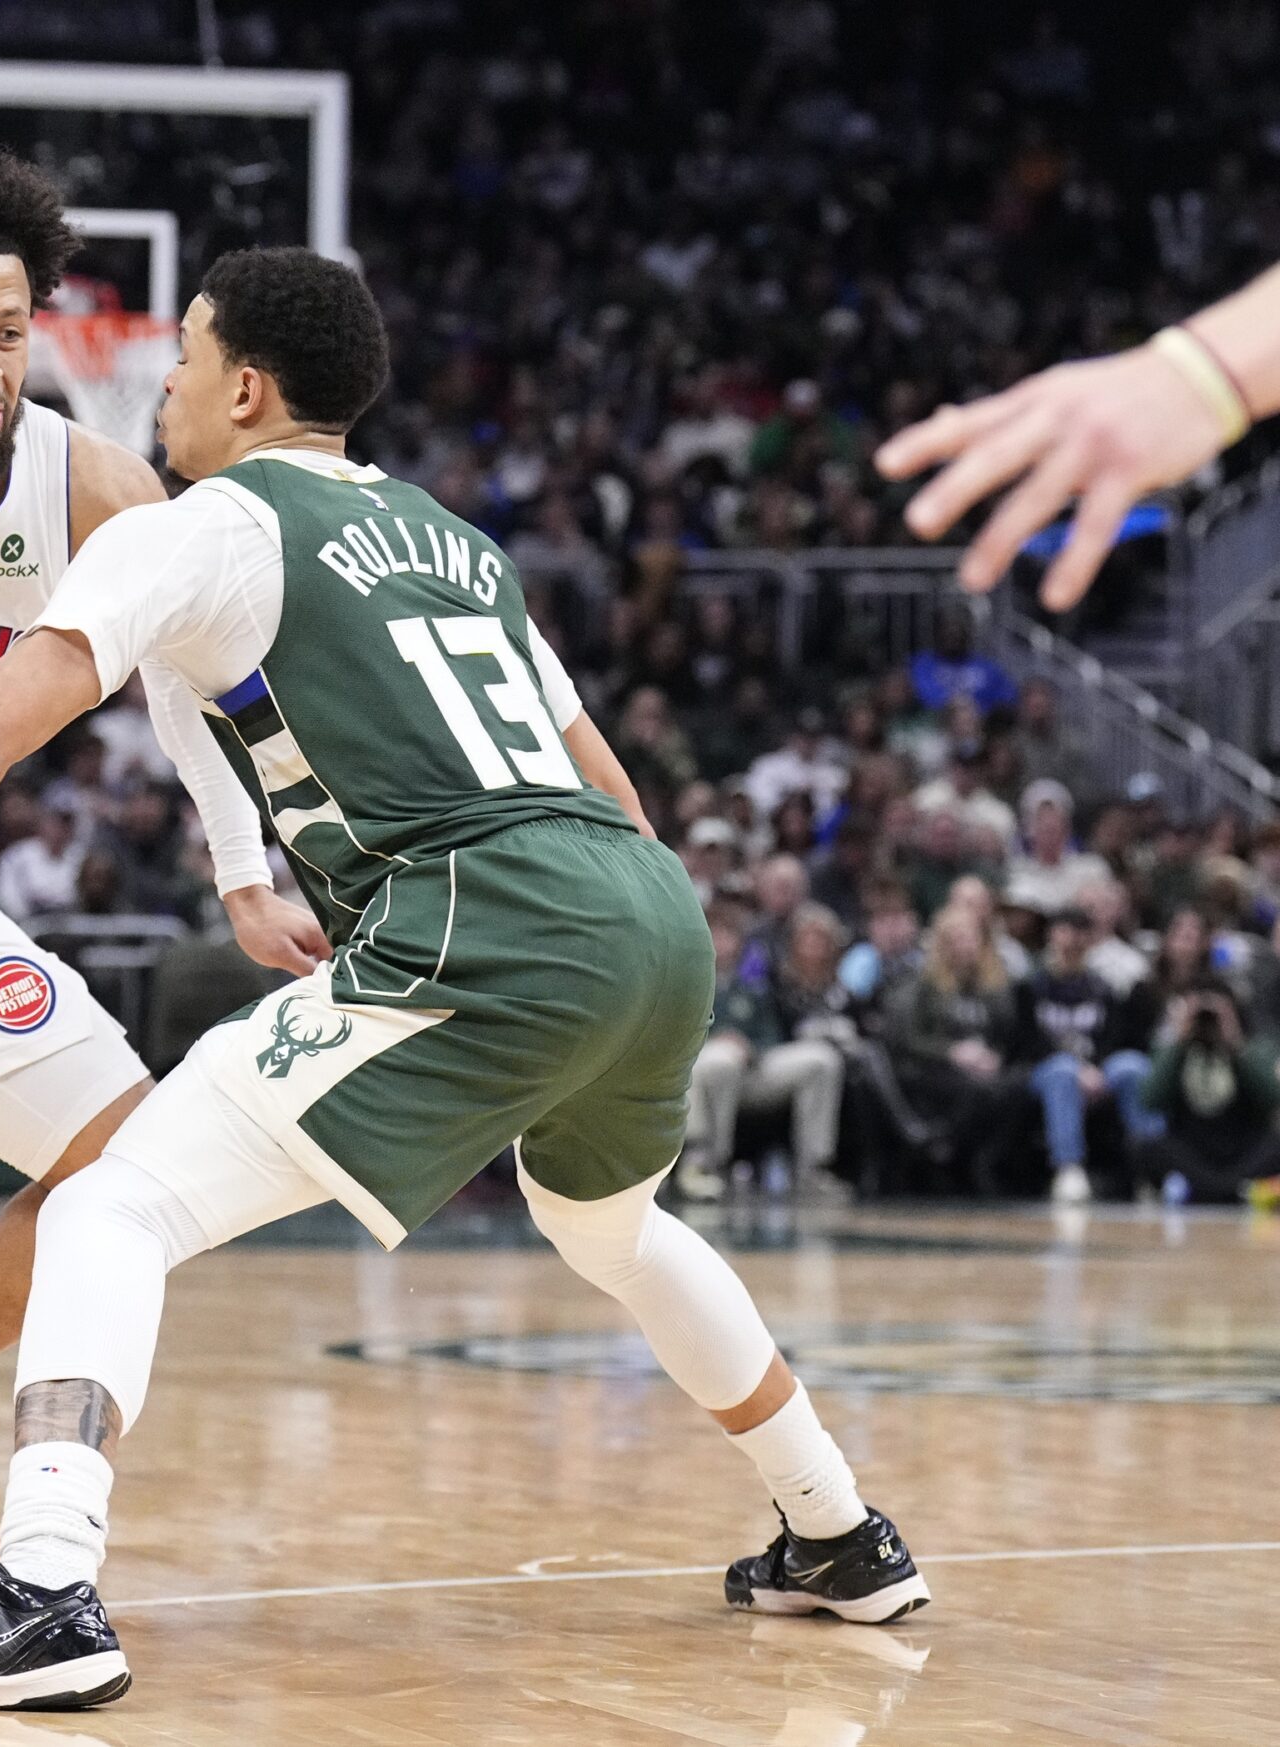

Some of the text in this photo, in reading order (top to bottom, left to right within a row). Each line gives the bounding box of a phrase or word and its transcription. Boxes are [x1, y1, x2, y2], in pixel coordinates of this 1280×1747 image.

[317, 517, 503, 606] ROLLINS
[386, 617, 583, 790] 13
[877, 1541, 894, 1560] 24
